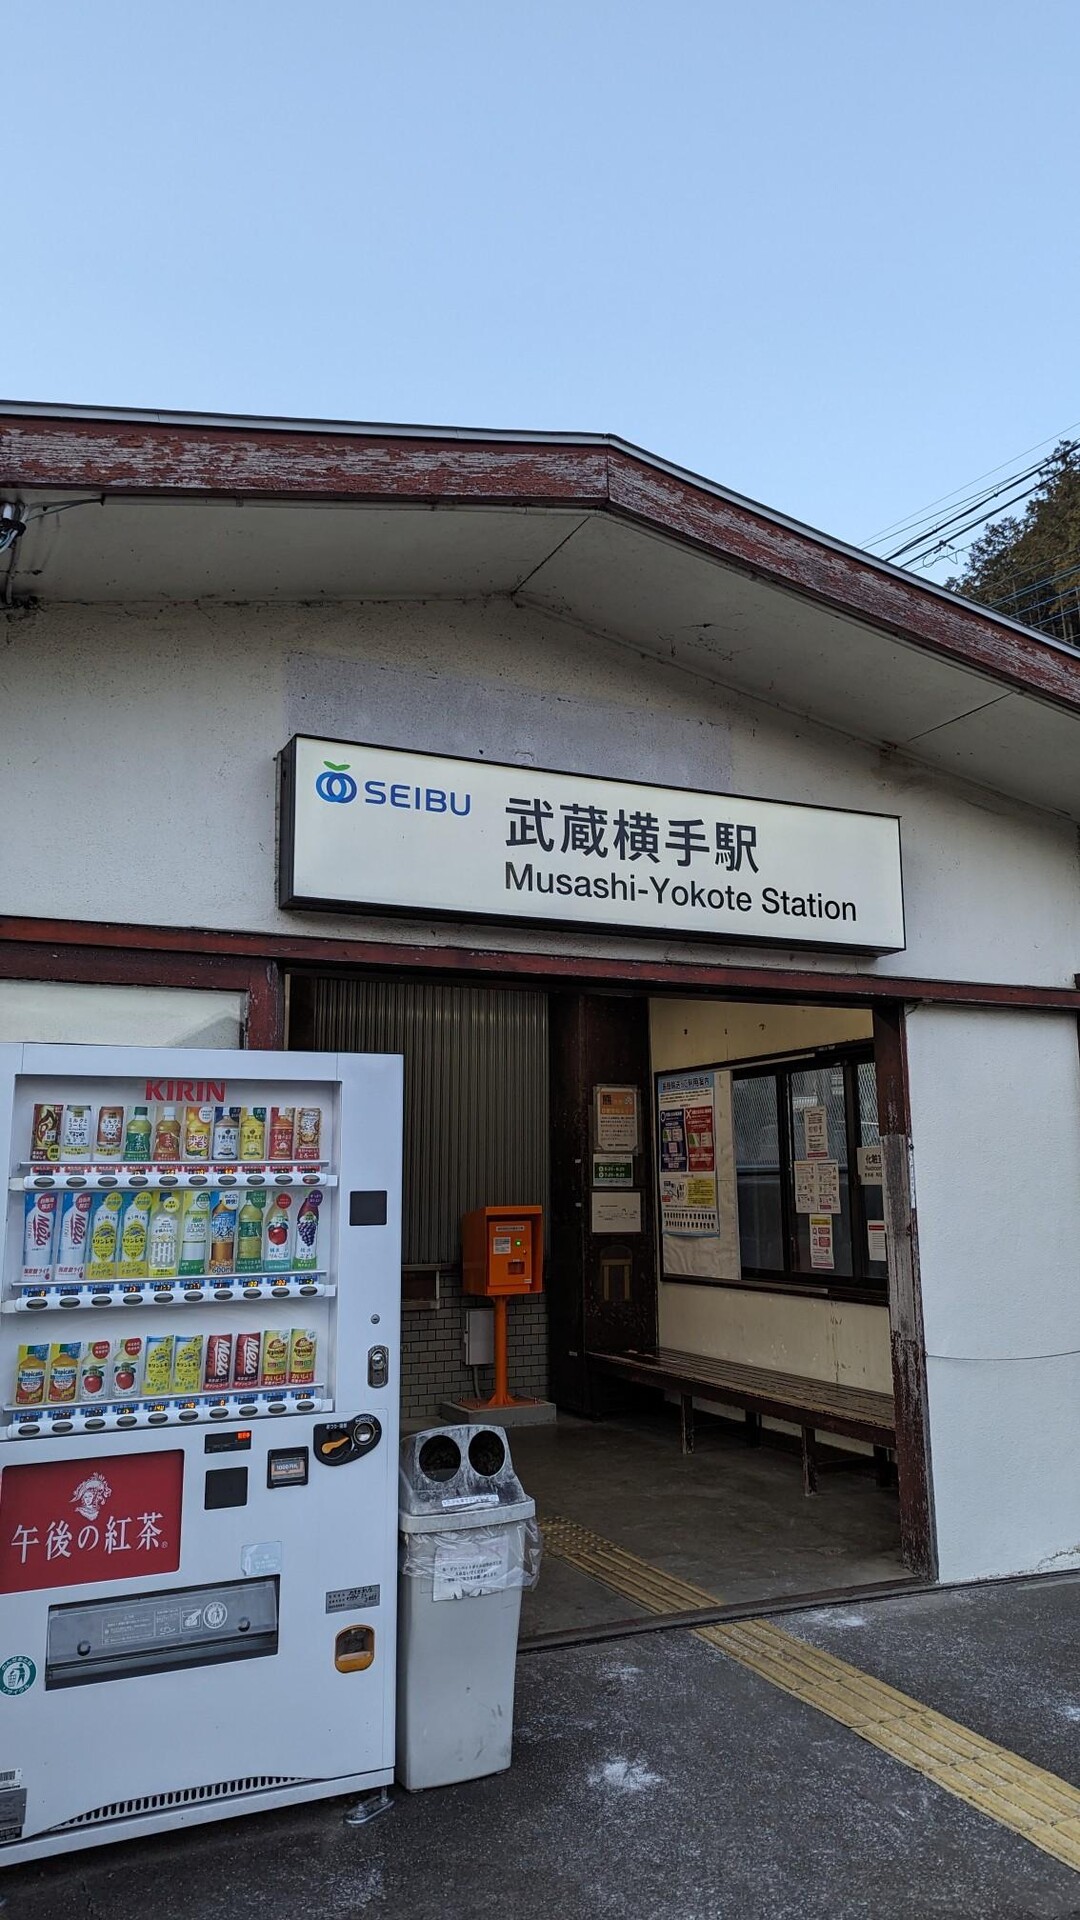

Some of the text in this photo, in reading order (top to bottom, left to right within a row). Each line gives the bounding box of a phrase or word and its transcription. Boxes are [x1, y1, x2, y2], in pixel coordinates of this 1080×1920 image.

[364, 780, 471, 816] SEIBU
[505, 797, 759, 874] 武蔵横手駅
[504, 861, 857, 921] Musashi-Yokote Station
[145, 1080, 225, 1103] KIRIN
[36, 1214, 51, 1246] Mets
[72, 1214, 86, 1245] Mets
[21, 1368, 43, 1377] Tropicana
[53, 1368, 75, 1376] Tropicana
[217, 1340, 230, 1376] Mets
[245, 1337, 259, 1374] Mets
[11, 1512, 164, 1564] 午後の紅茶
